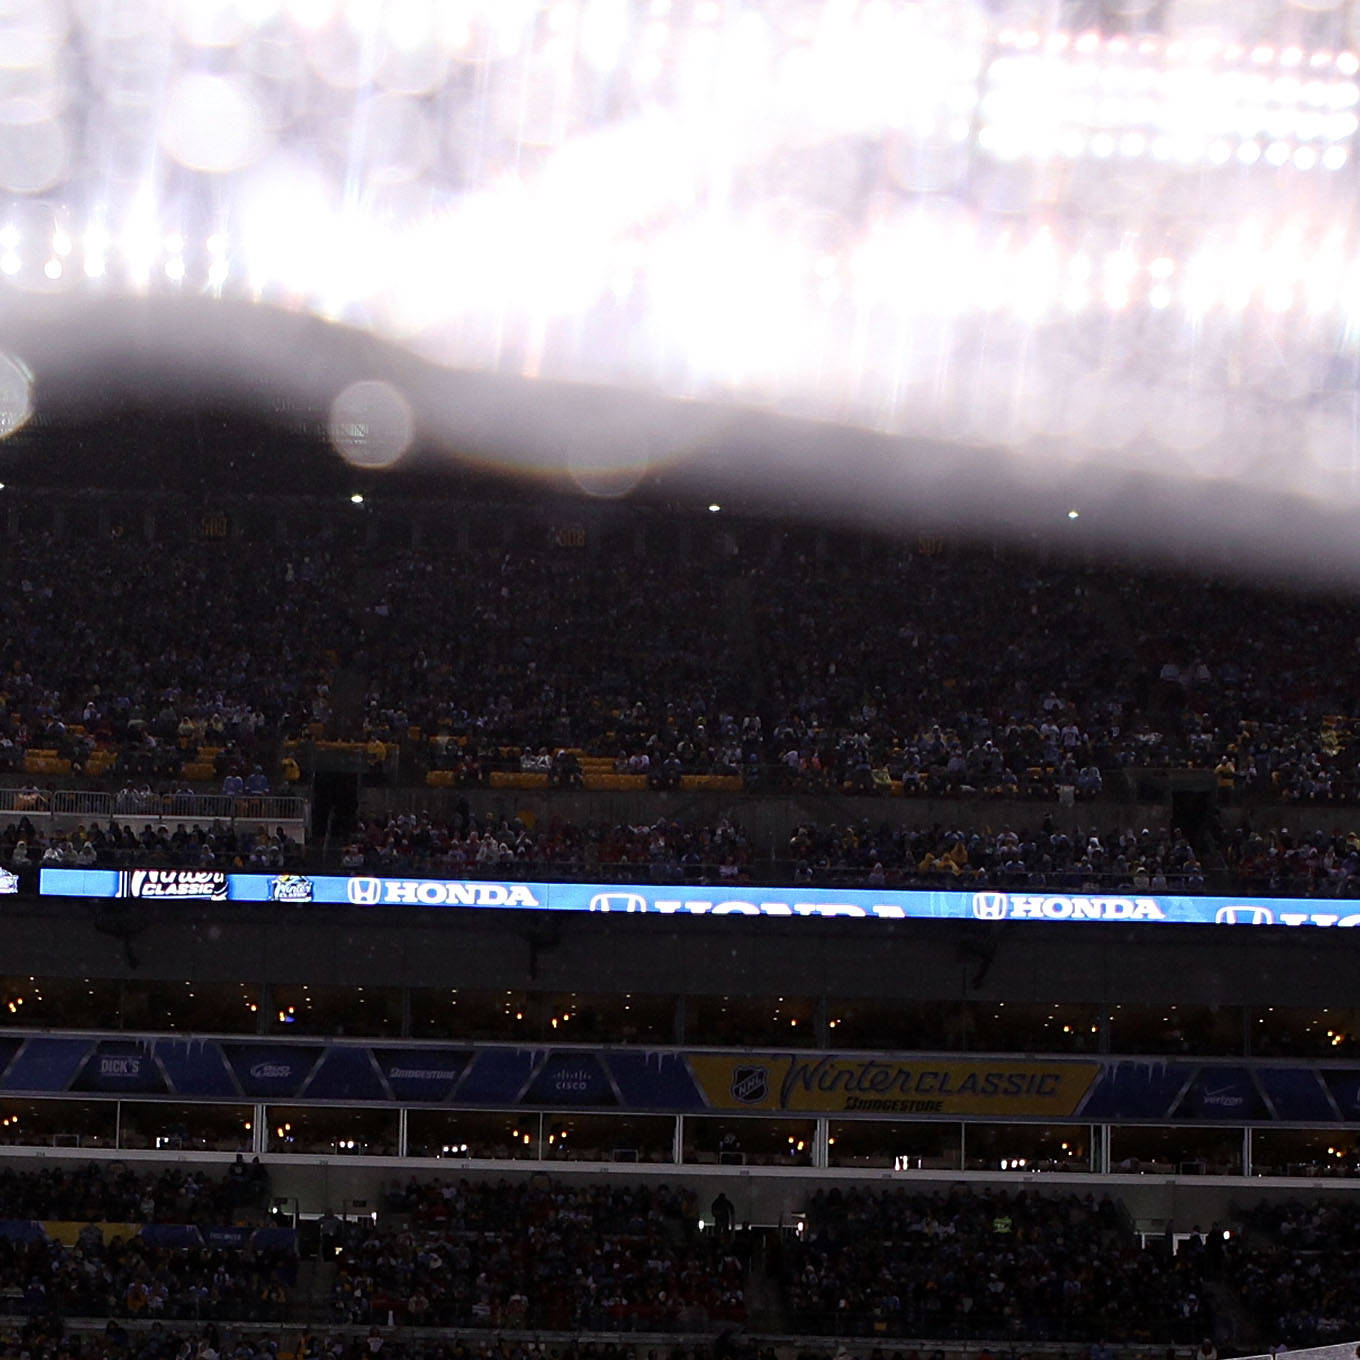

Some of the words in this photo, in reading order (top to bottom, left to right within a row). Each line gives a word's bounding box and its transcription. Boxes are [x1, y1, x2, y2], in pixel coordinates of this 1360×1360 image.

[141, 883, 215, 895] CLASSIC
[384, 882, 539, 907] HONDA
[1010, 896, 1166, 919] HONDA
[100, 1058, 140, 1073] DICK'S
[772, 1053, 917, 1109] Winter
[915, 1073, 1060, 1096] CLASSIC
[843, 1096, 944, 1112] BRIDGESTONE
